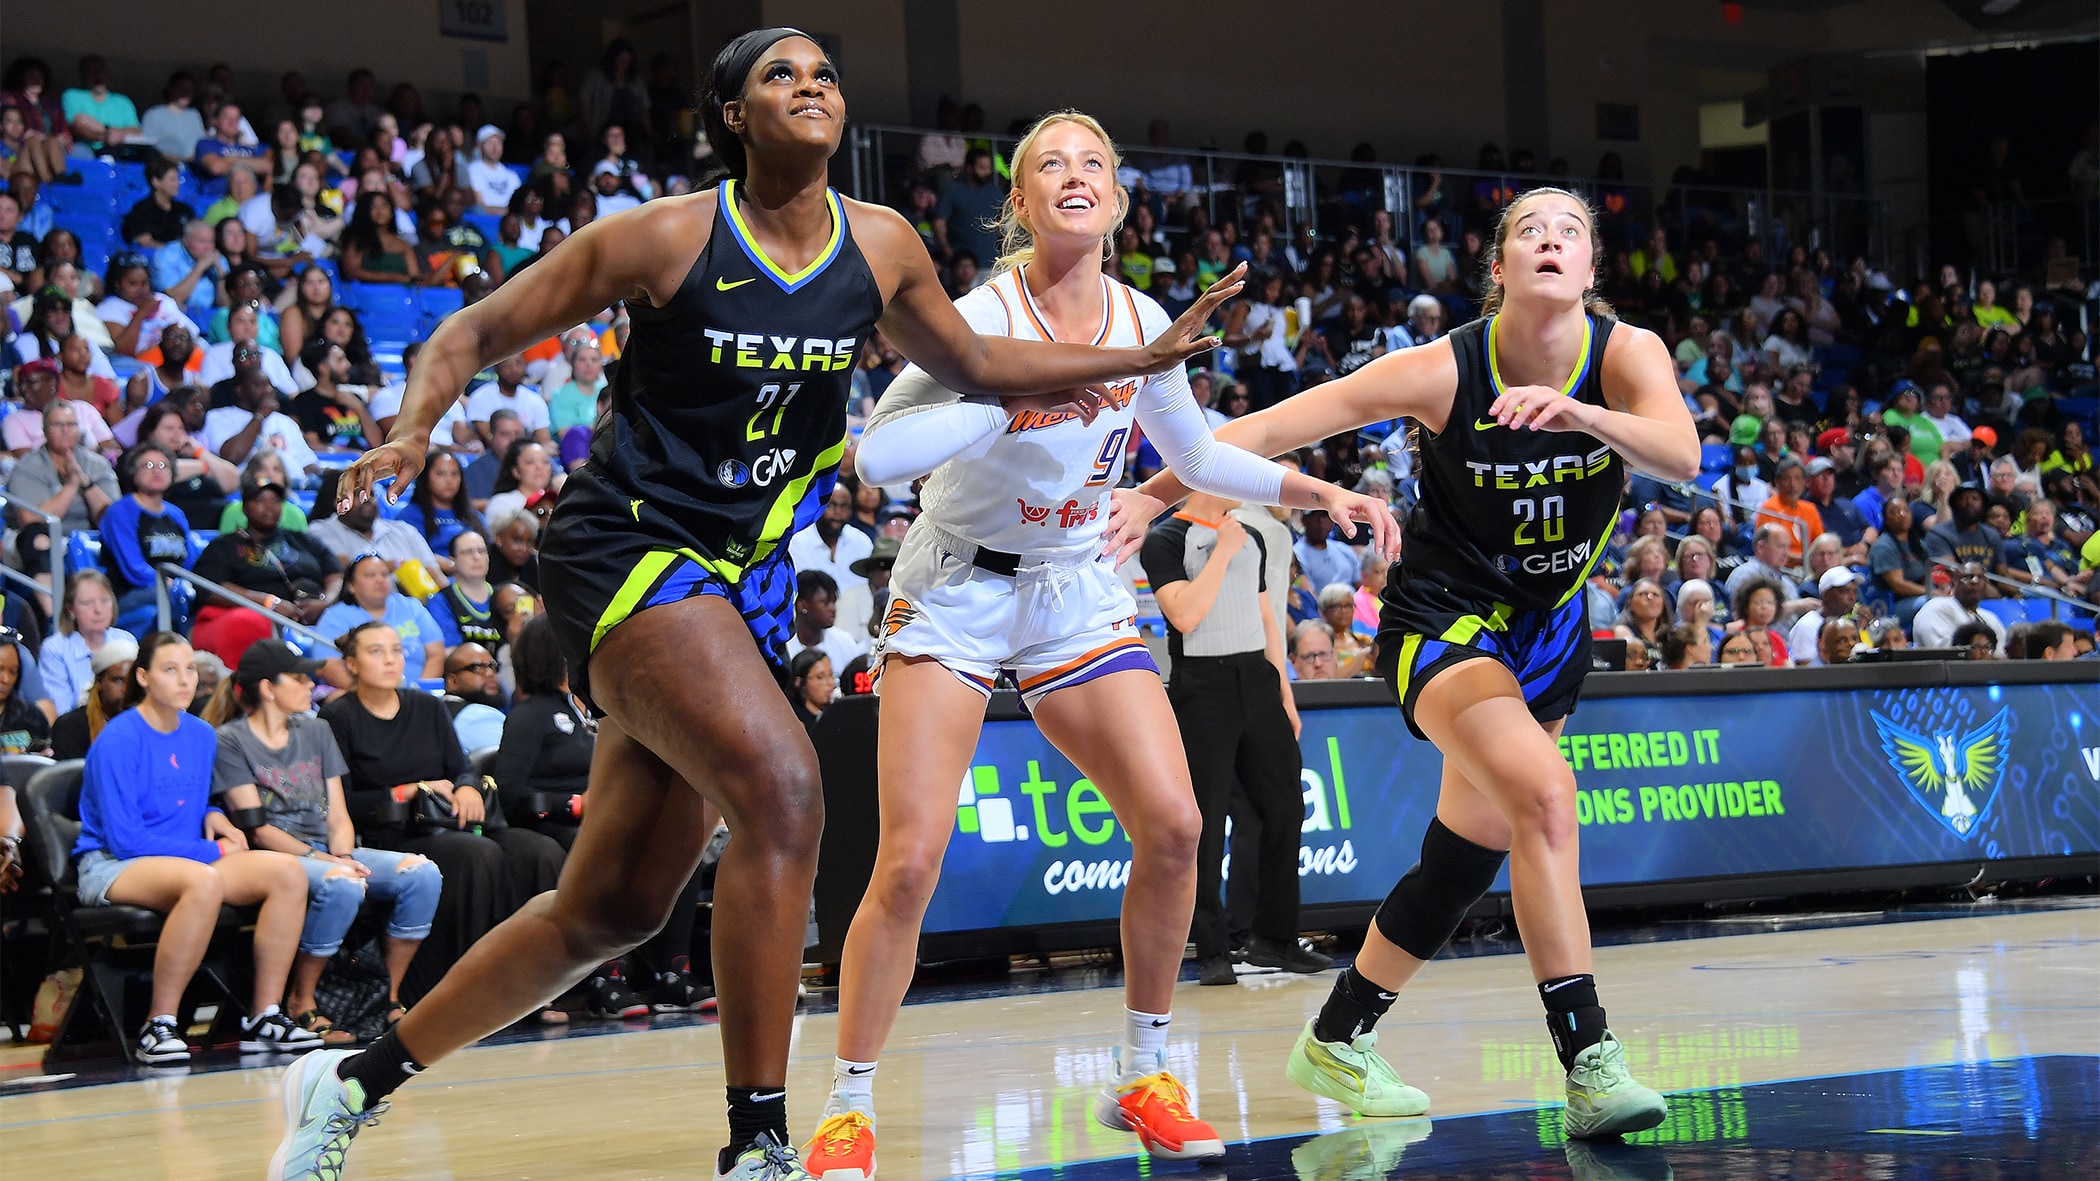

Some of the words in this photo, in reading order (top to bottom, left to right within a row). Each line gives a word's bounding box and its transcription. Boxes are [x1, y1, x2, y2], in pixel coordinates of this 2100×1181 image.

[703, 328, 857, 372] TEXAS
[746, 381, 804, 443] 21
[1084, 427, 1128, 487] 9
[1466, 444, 1610, 489] TEXAS
[1512, 495, 1565, 546] 20
[1522, 538, 1591, 575] GEM
[1693, 729, 1720, 764] IT
[1638, 779, 1786, 823] PROVIDER
